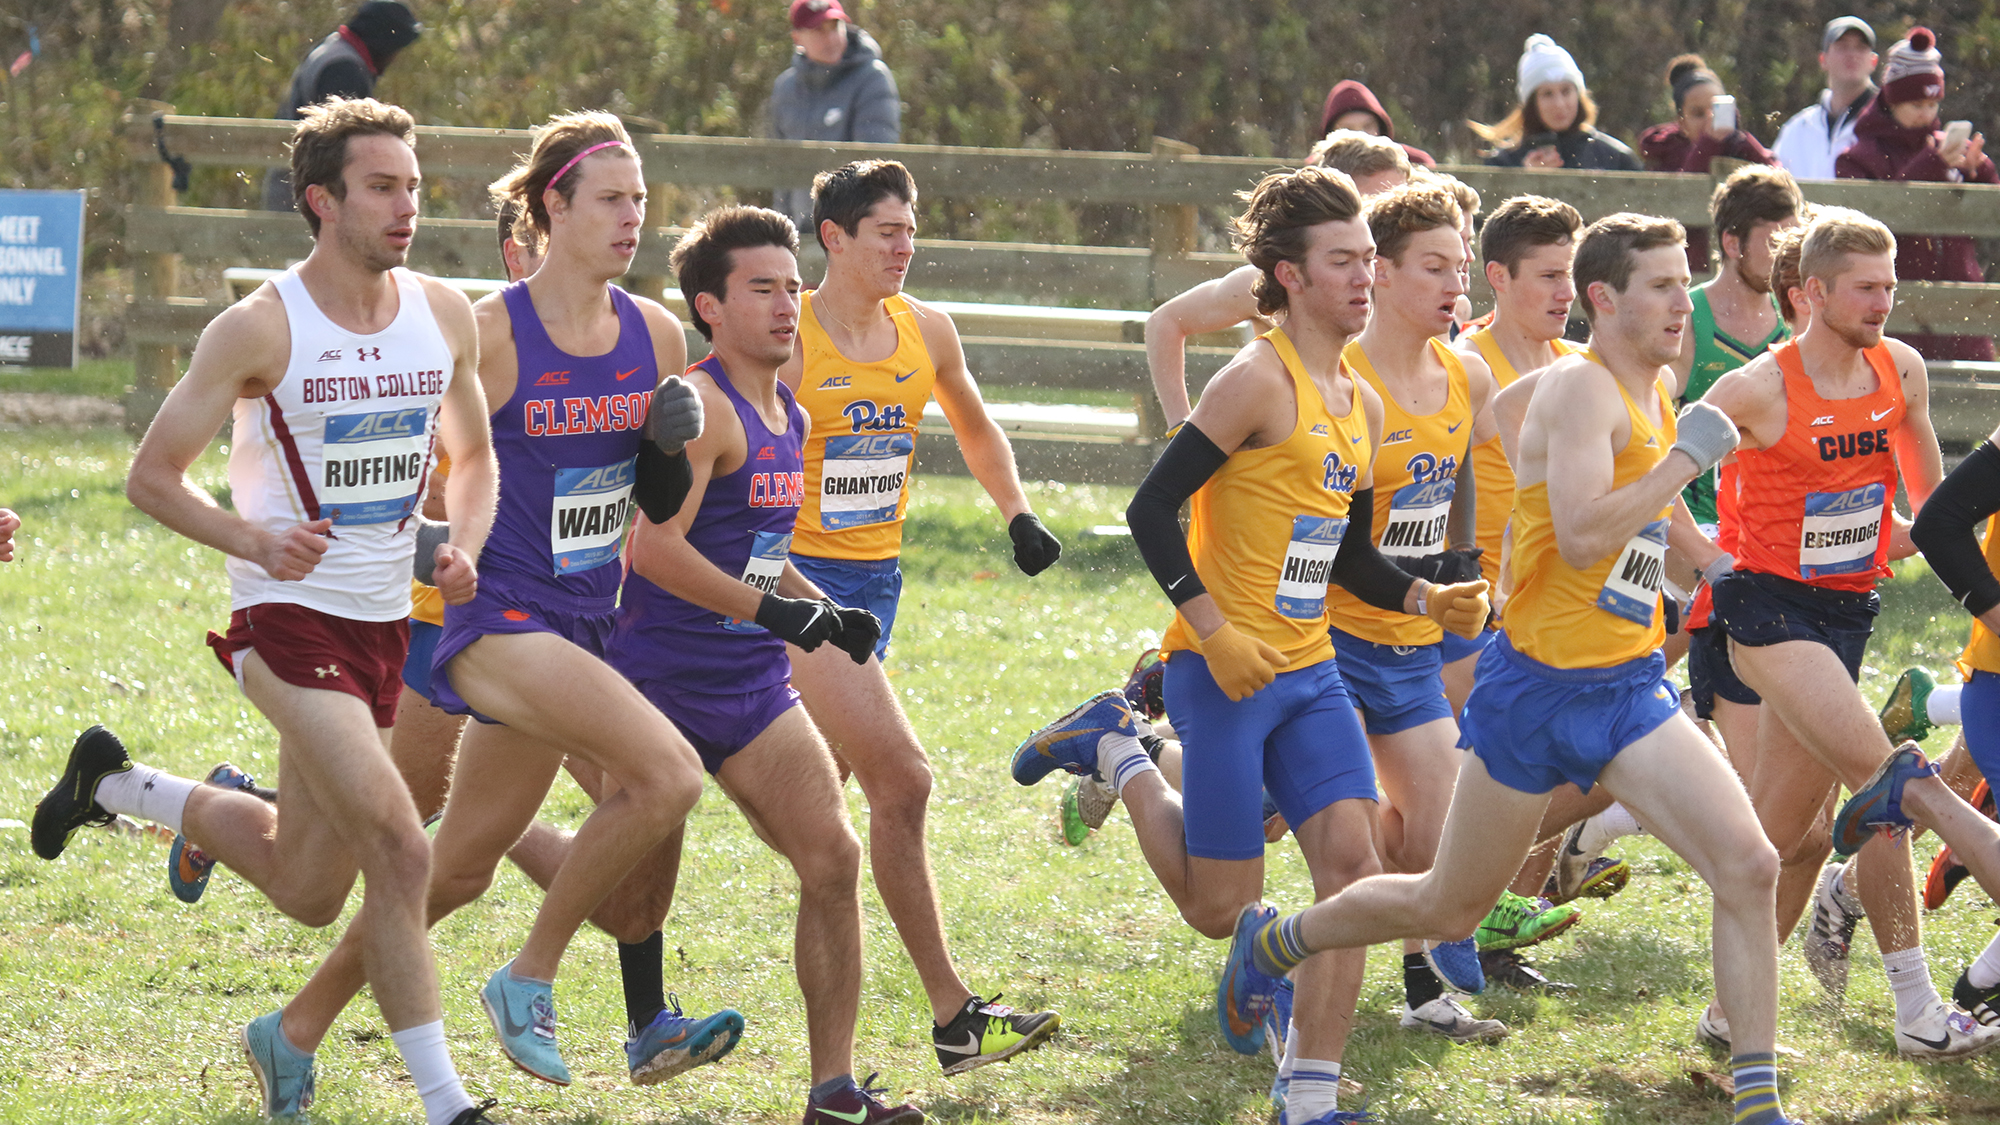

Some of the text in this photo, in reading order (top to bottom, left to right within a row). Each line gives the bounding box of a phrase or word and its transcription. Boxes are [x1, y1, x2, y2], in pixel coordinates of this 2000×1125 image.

[318, 350, 342, 361] ACC
[303, 370, 443, 403] BOSTON COLLEGE
[535, 371, 571, 385] ACC
[818, 376, 852, 389] ACC
[342, 410, 417, 439] ACC
[842, 399, 906, 433] Pitt
[1310, 424, 1329, 436] ACC
[1811, 415, 1834, 426] ACC
[843, 436, 904, 456] ACC
[1382, 428, 1413, 445] ACC
[757, 446, 775, 459] ACC
[325, 452, 420, 487] RUFFING
[571, 460, 631, 490] ACC
[1322, 451, 1358, 493] Pitt
[1405, 451, 1457, 484] Pitt
[824, 472, 904, 495] GHANTOUS
[1407, 479, 1453, 505] ACC
[1823, 484, 1878, 512] ACC
[559, 497, 627, 540] WARD
[1382, 514, 1446, 546] MILLER
[1804, 520, 1879, 548] BEVERIDGE
